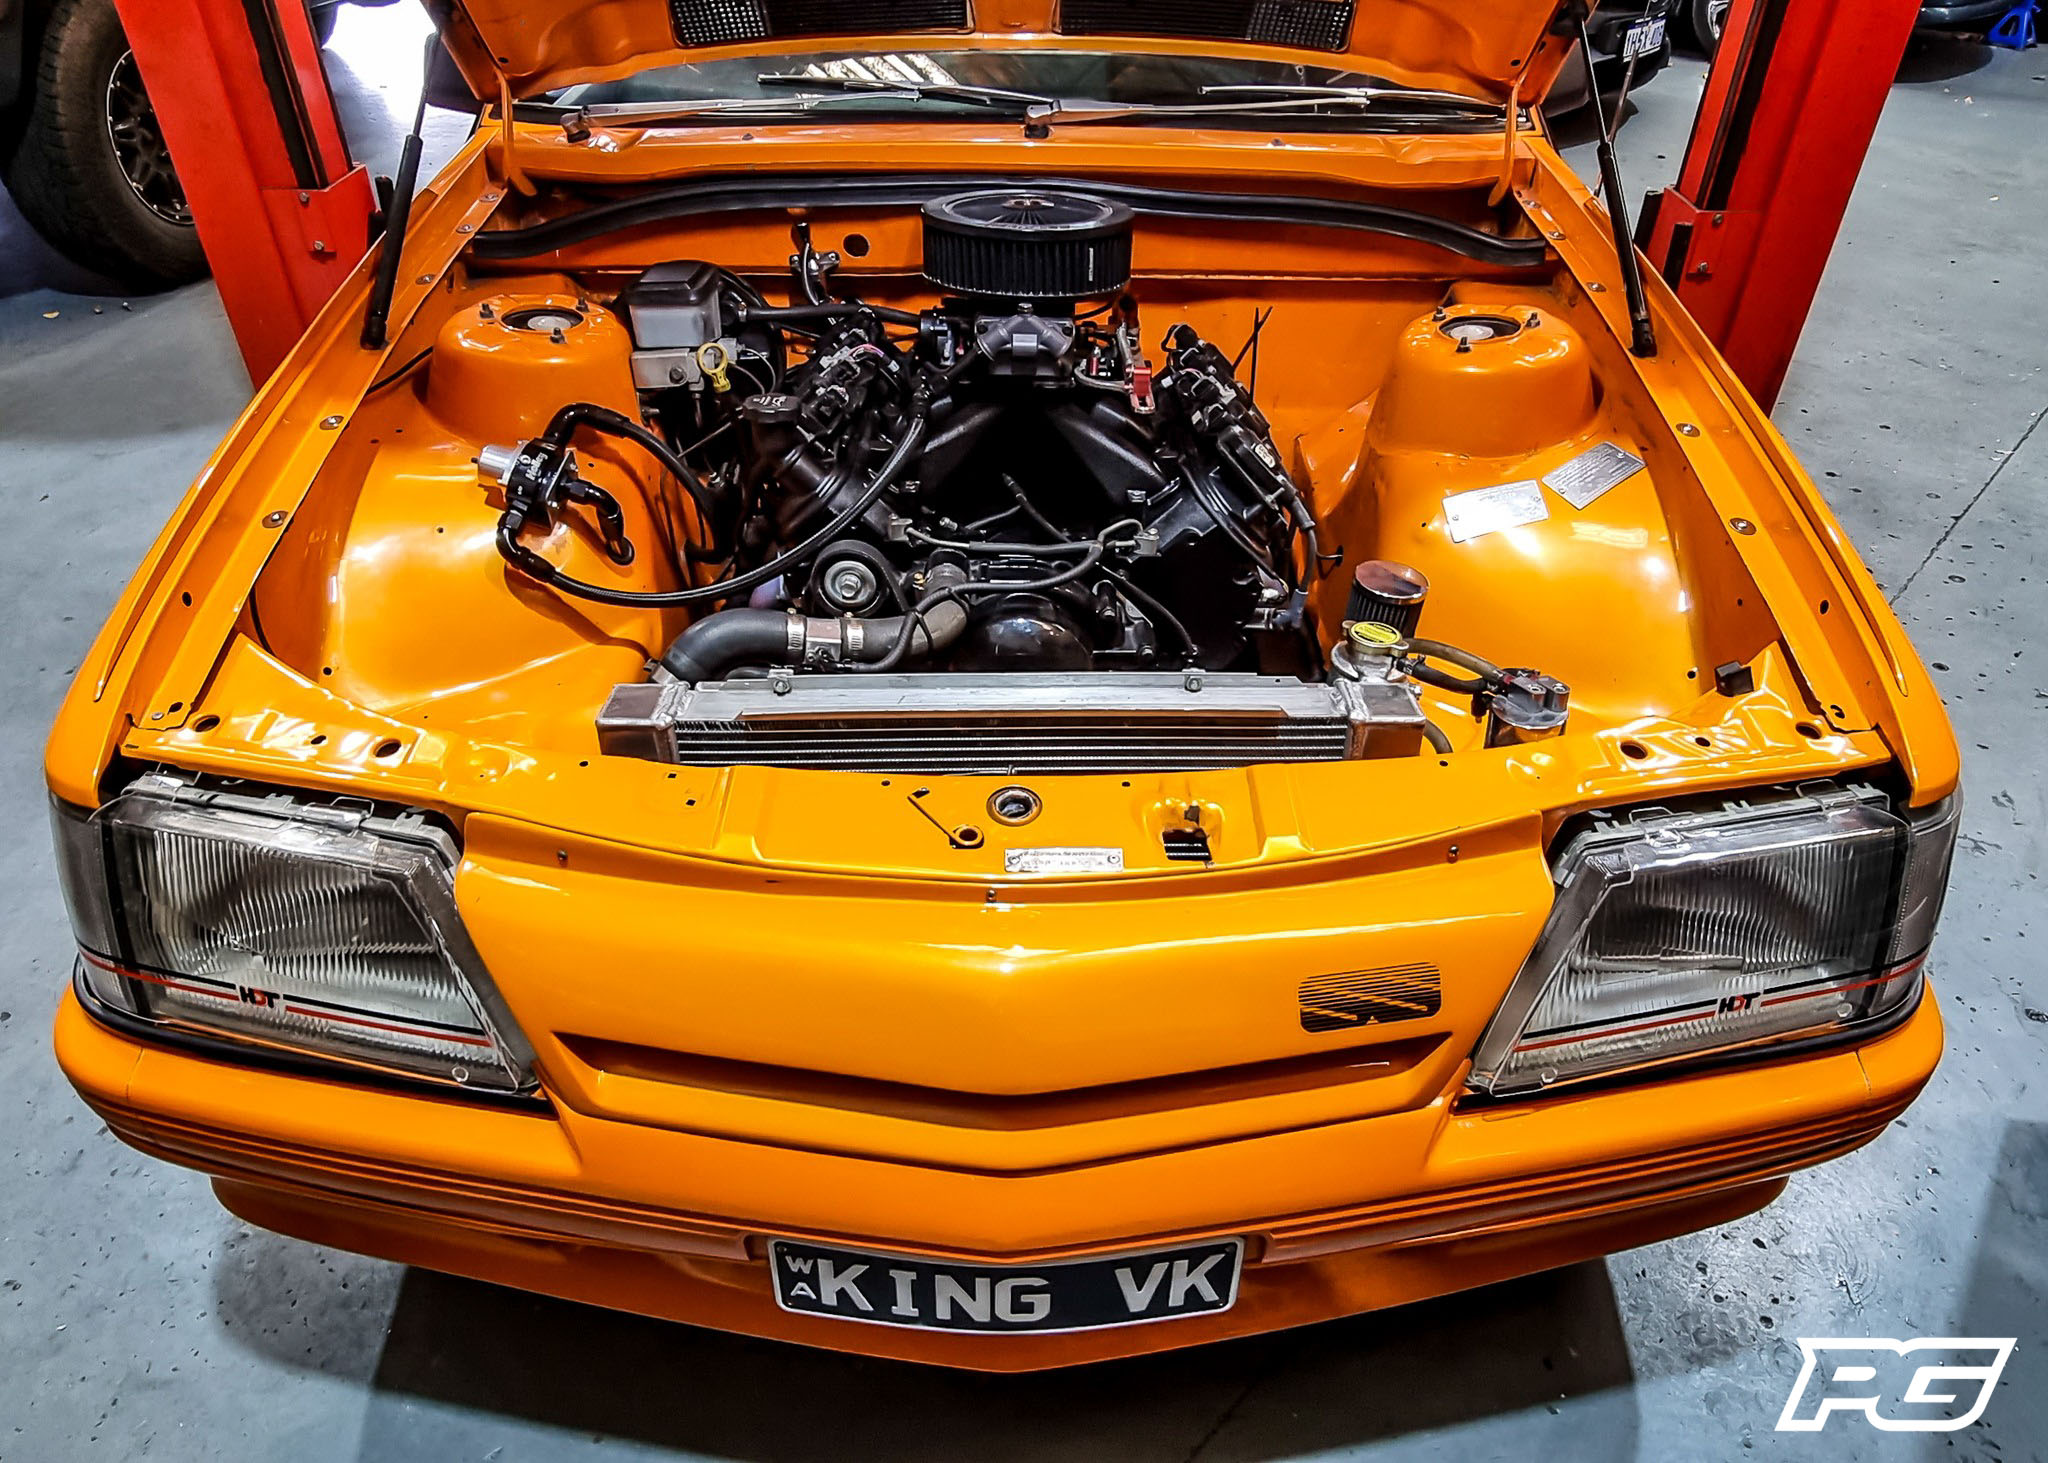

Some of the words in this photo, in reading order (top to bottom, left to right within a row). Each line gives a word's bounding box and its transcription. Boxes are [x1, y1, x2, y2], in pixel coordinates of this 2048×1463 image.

[525, 452, 548, 480] Holley
[239, 985, 280, 1009] HDT
[1718, 992, 1761, 1014] HDT
[817, 1259, 1052, 1322] KING
[1113, 1253, 1226, 1313] VK
